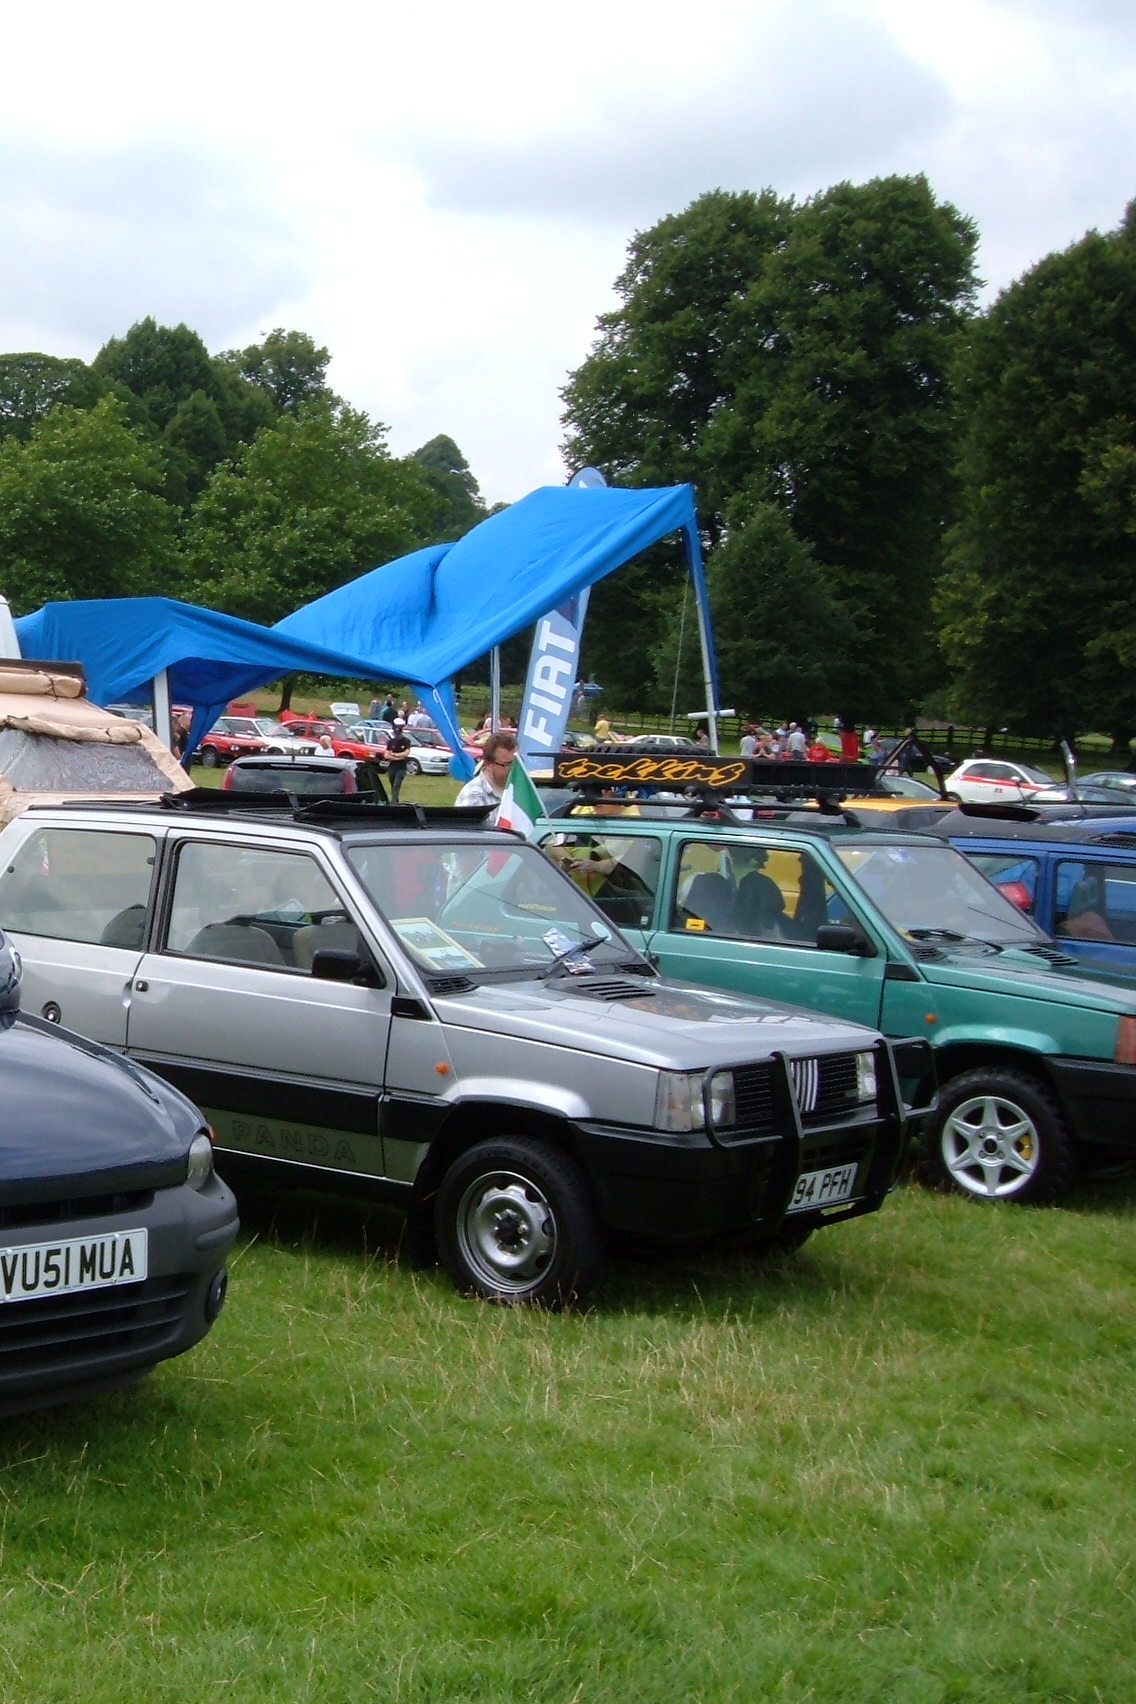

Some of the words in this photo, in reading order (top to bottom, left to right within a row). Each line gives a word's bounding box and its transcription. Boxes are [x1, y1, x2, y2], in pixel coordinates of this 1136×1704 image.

[523, 619, 577, 747] FIAT
[230, 1118, 358, 1163] PANDA
[819, 1168, 852, 1200] PFH
[0, 1246, 70, 1294] VU51
[79, 1238, 135, 1284] MUA
